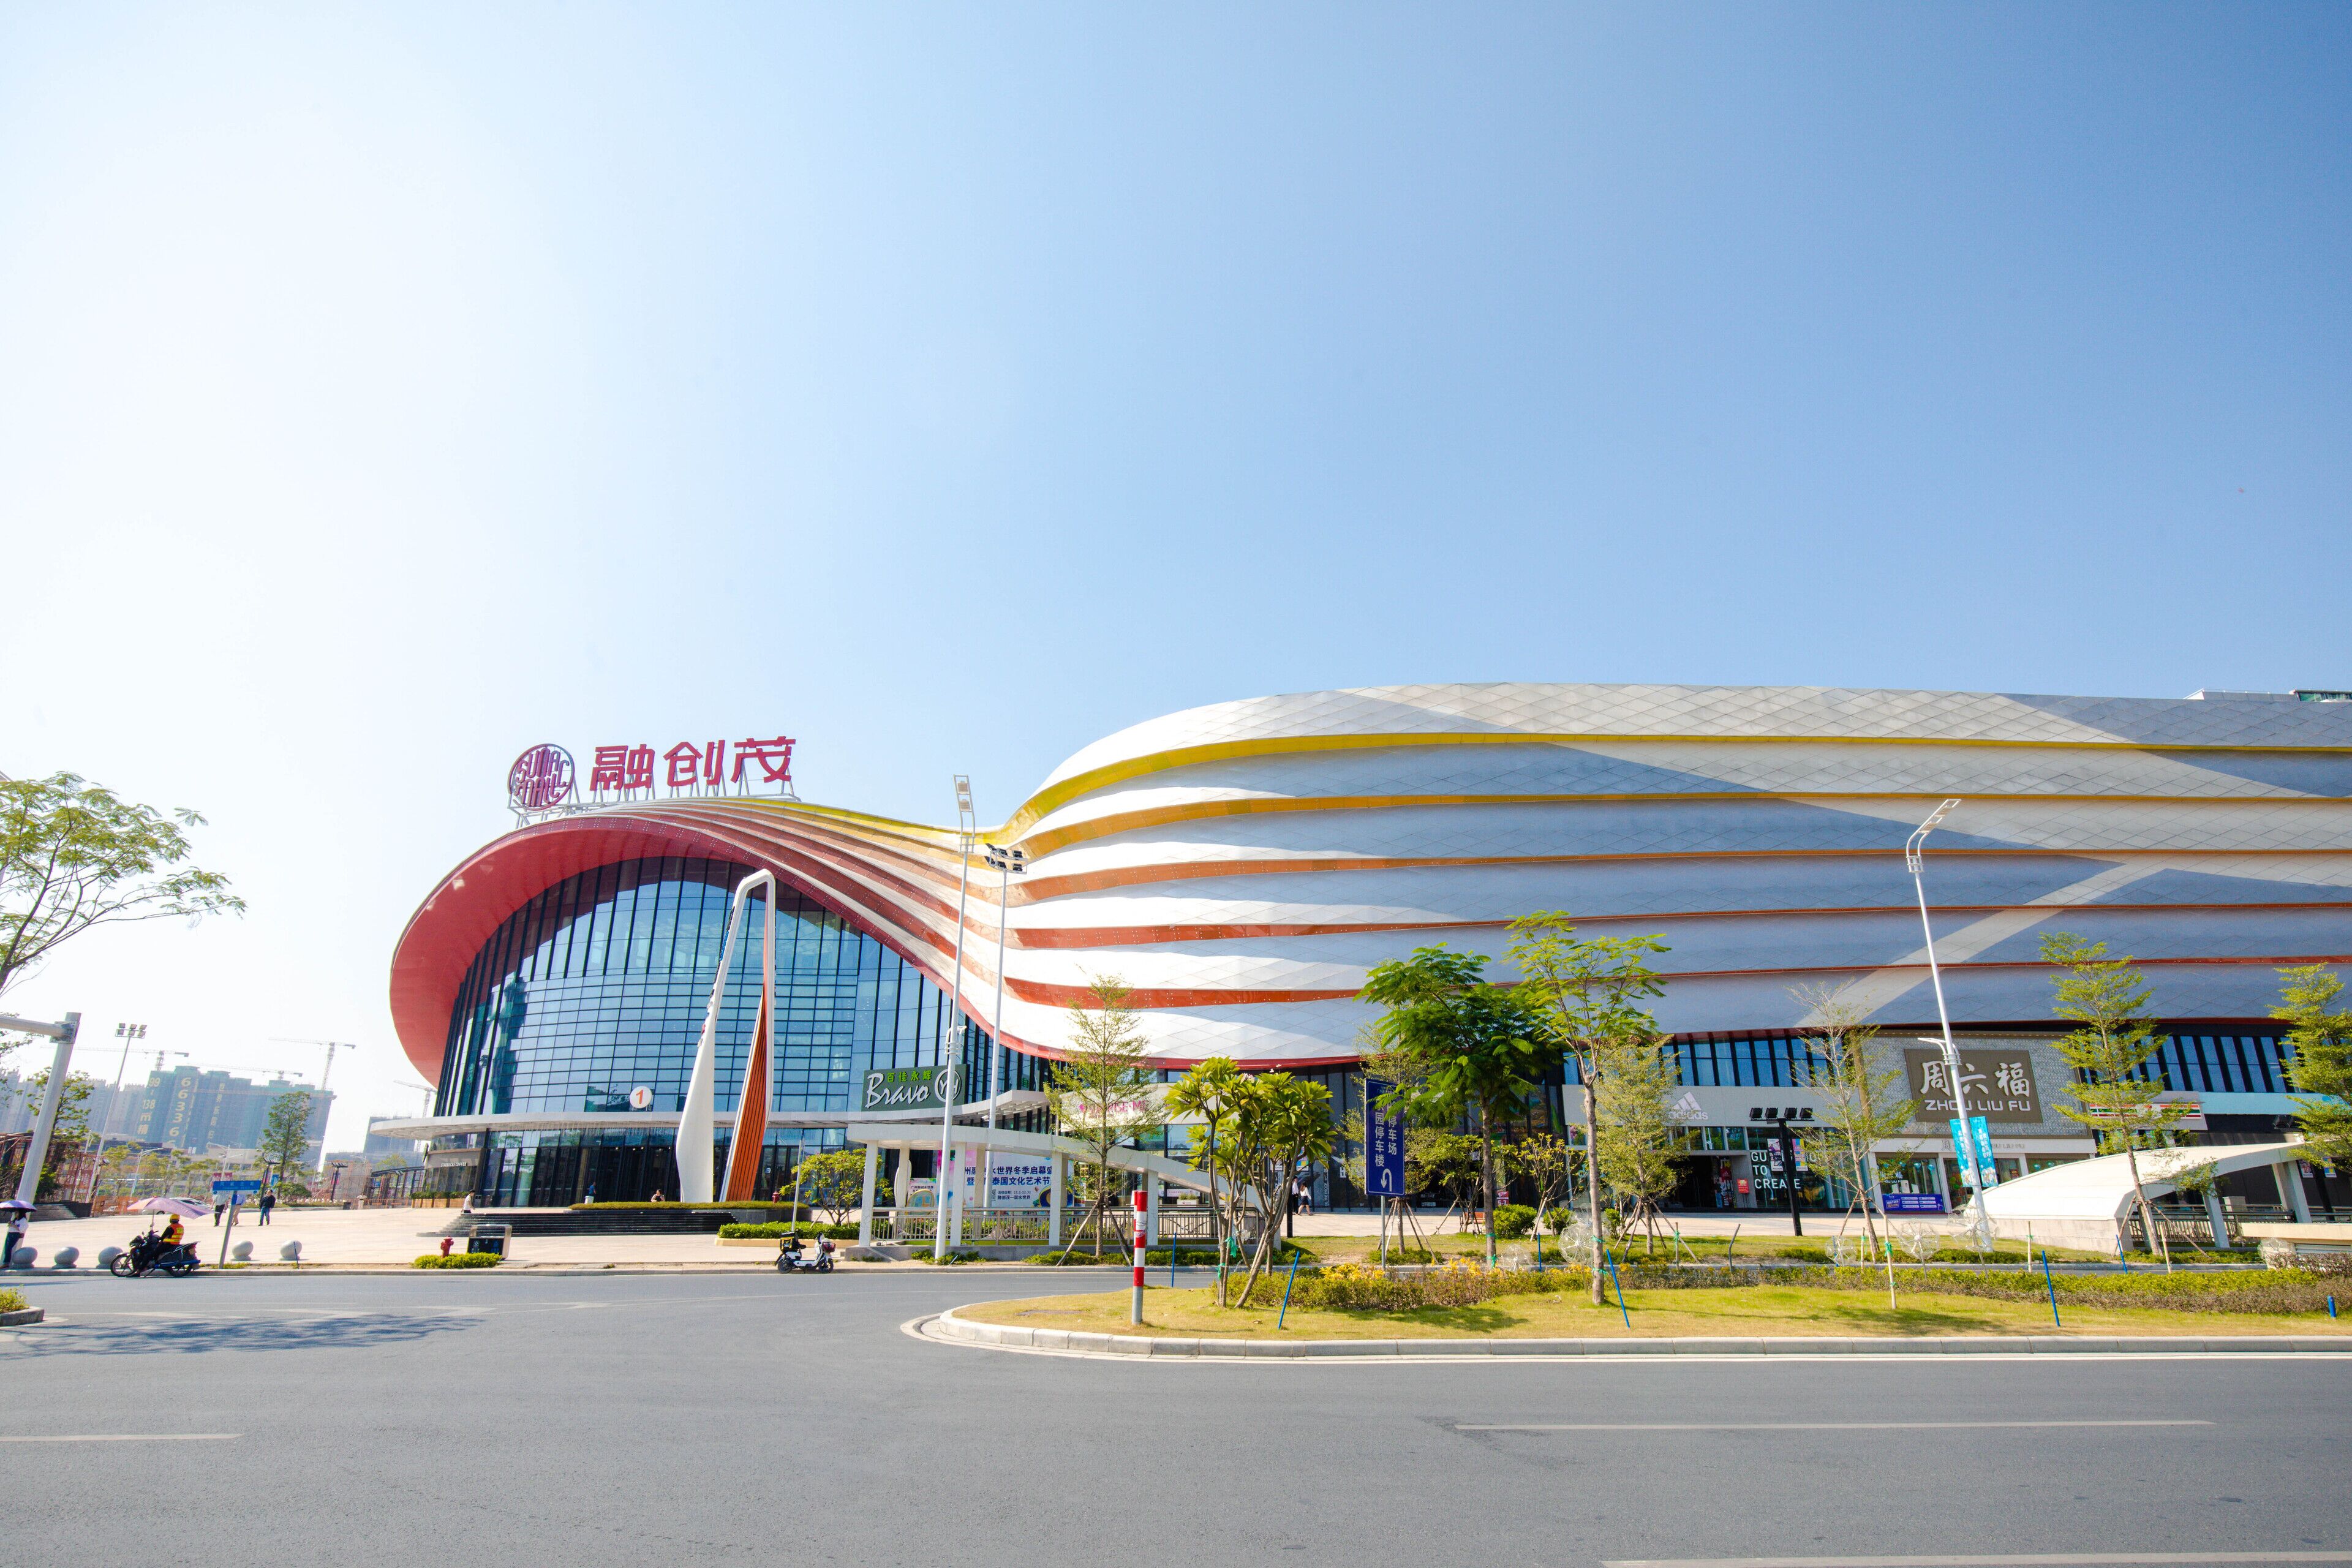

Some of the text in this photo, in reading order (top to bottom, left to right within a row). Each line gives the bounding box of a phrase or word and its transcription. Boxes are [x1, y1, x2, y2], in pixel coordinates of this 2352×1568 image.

[589, 736, 796, 791] 融创茂
[888, 1070, 932, 1082] 百佳永辉
[1920, 1061, 2030, 1097] 周六福
[636, 1089, 644, 1104] 1
[865, 1072, 930, 1109] Bravo
[1977, 1100, 2003, 1111] LIU
[2008, 1101, 2030, 1111] FU
[1668, 1109, 1709, 1120] adidas
[1374, 1107, 1384, 1167] 园停车楼
[1752, 1165, 1767, 1175] TO
[1755, 1178, 1801, 1189] CREAE
